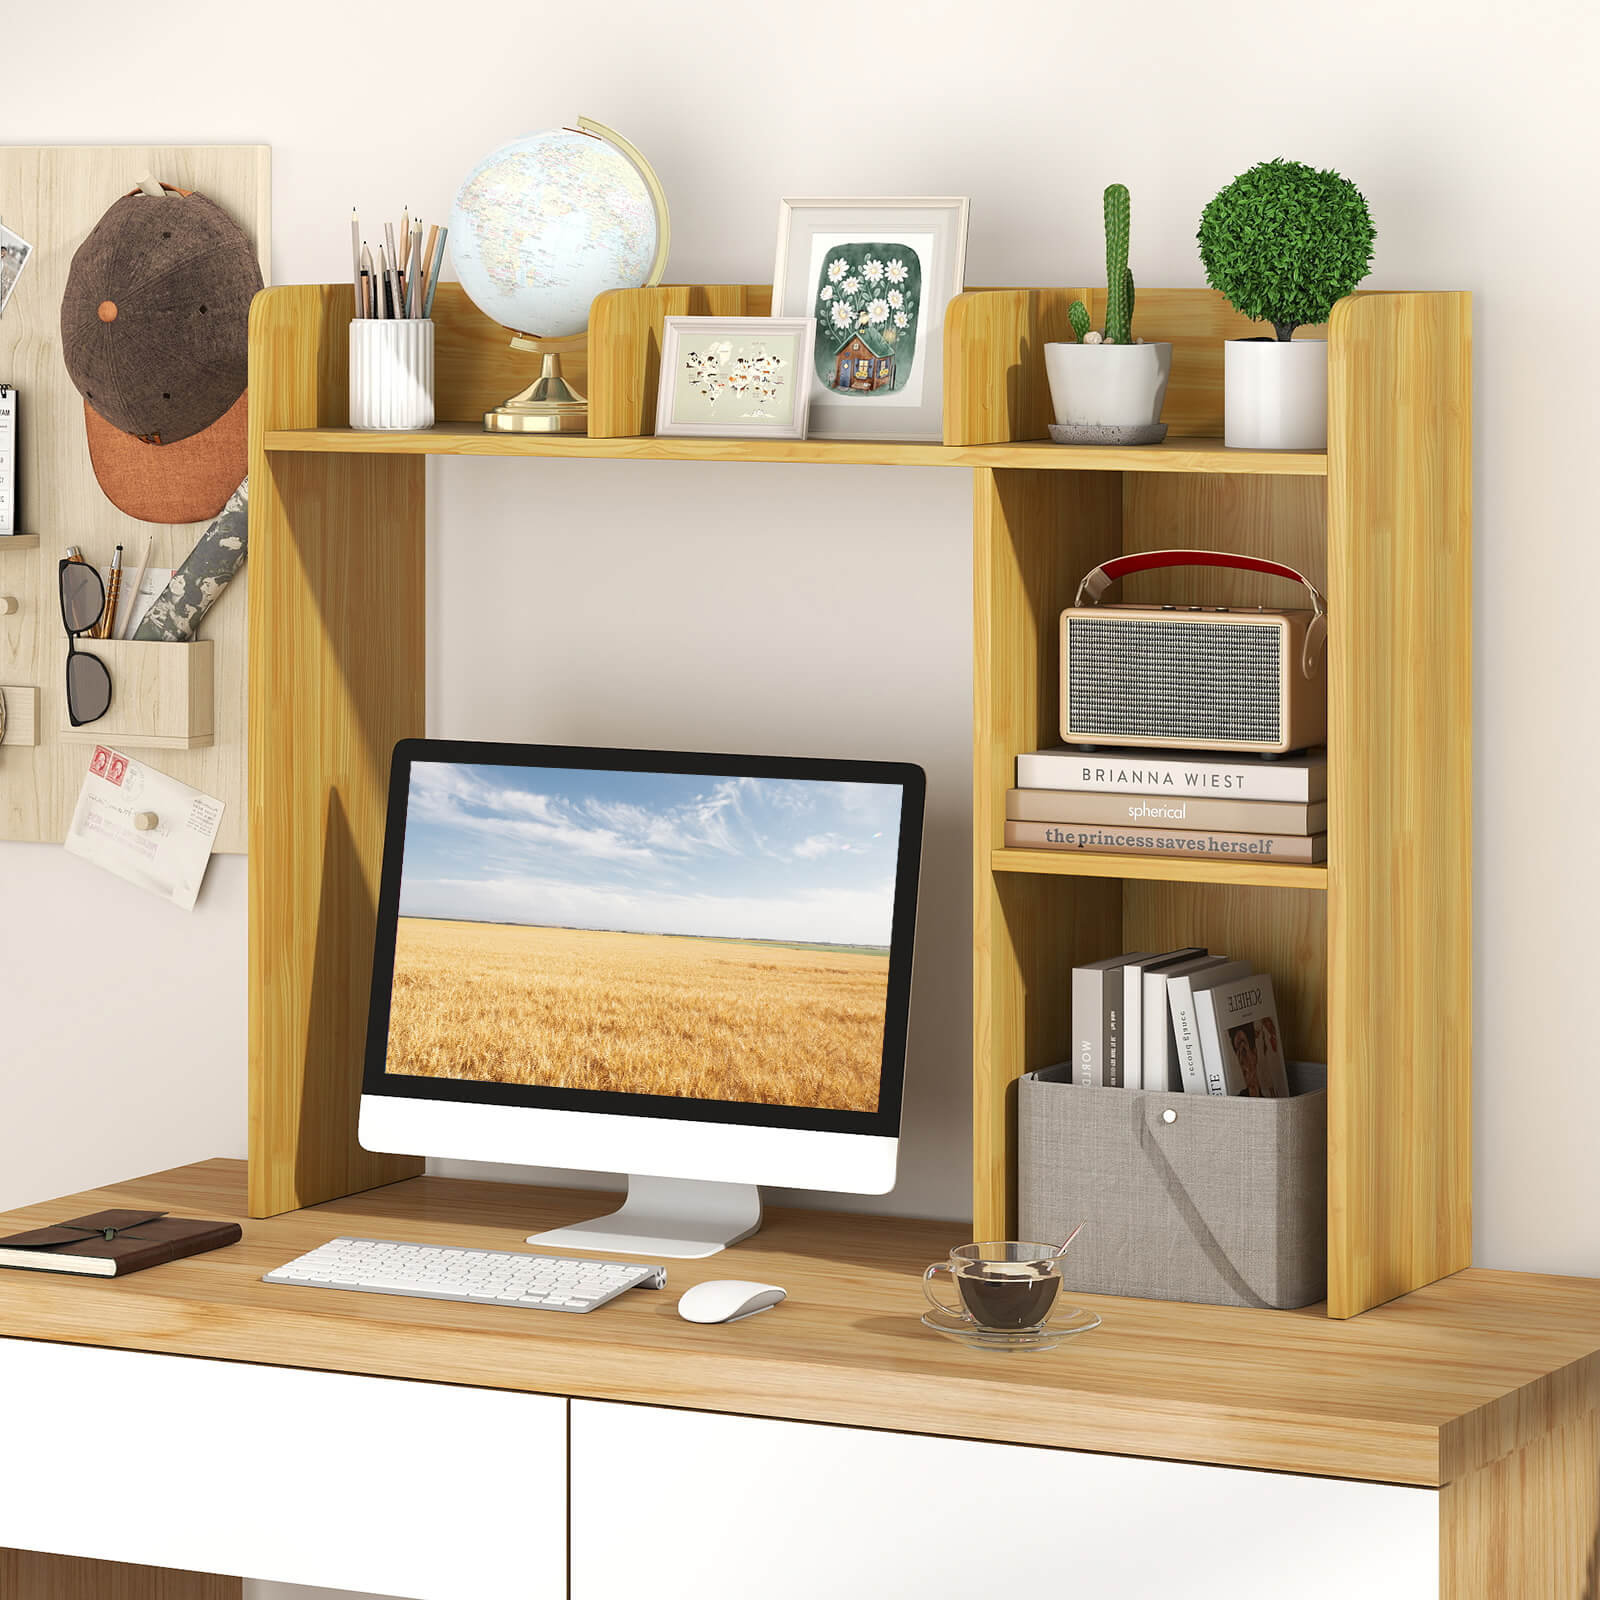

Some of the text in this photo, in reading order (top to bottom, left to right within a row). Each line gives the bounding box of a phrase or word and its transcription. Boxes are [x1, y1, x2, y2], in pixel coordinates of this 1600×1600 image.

[1082, 768, 1244, 789] BRIANNA WIEST
[1128, 800, 1186, 820] spherical
[1045, 828, 1274, 854] the princess saves herself
